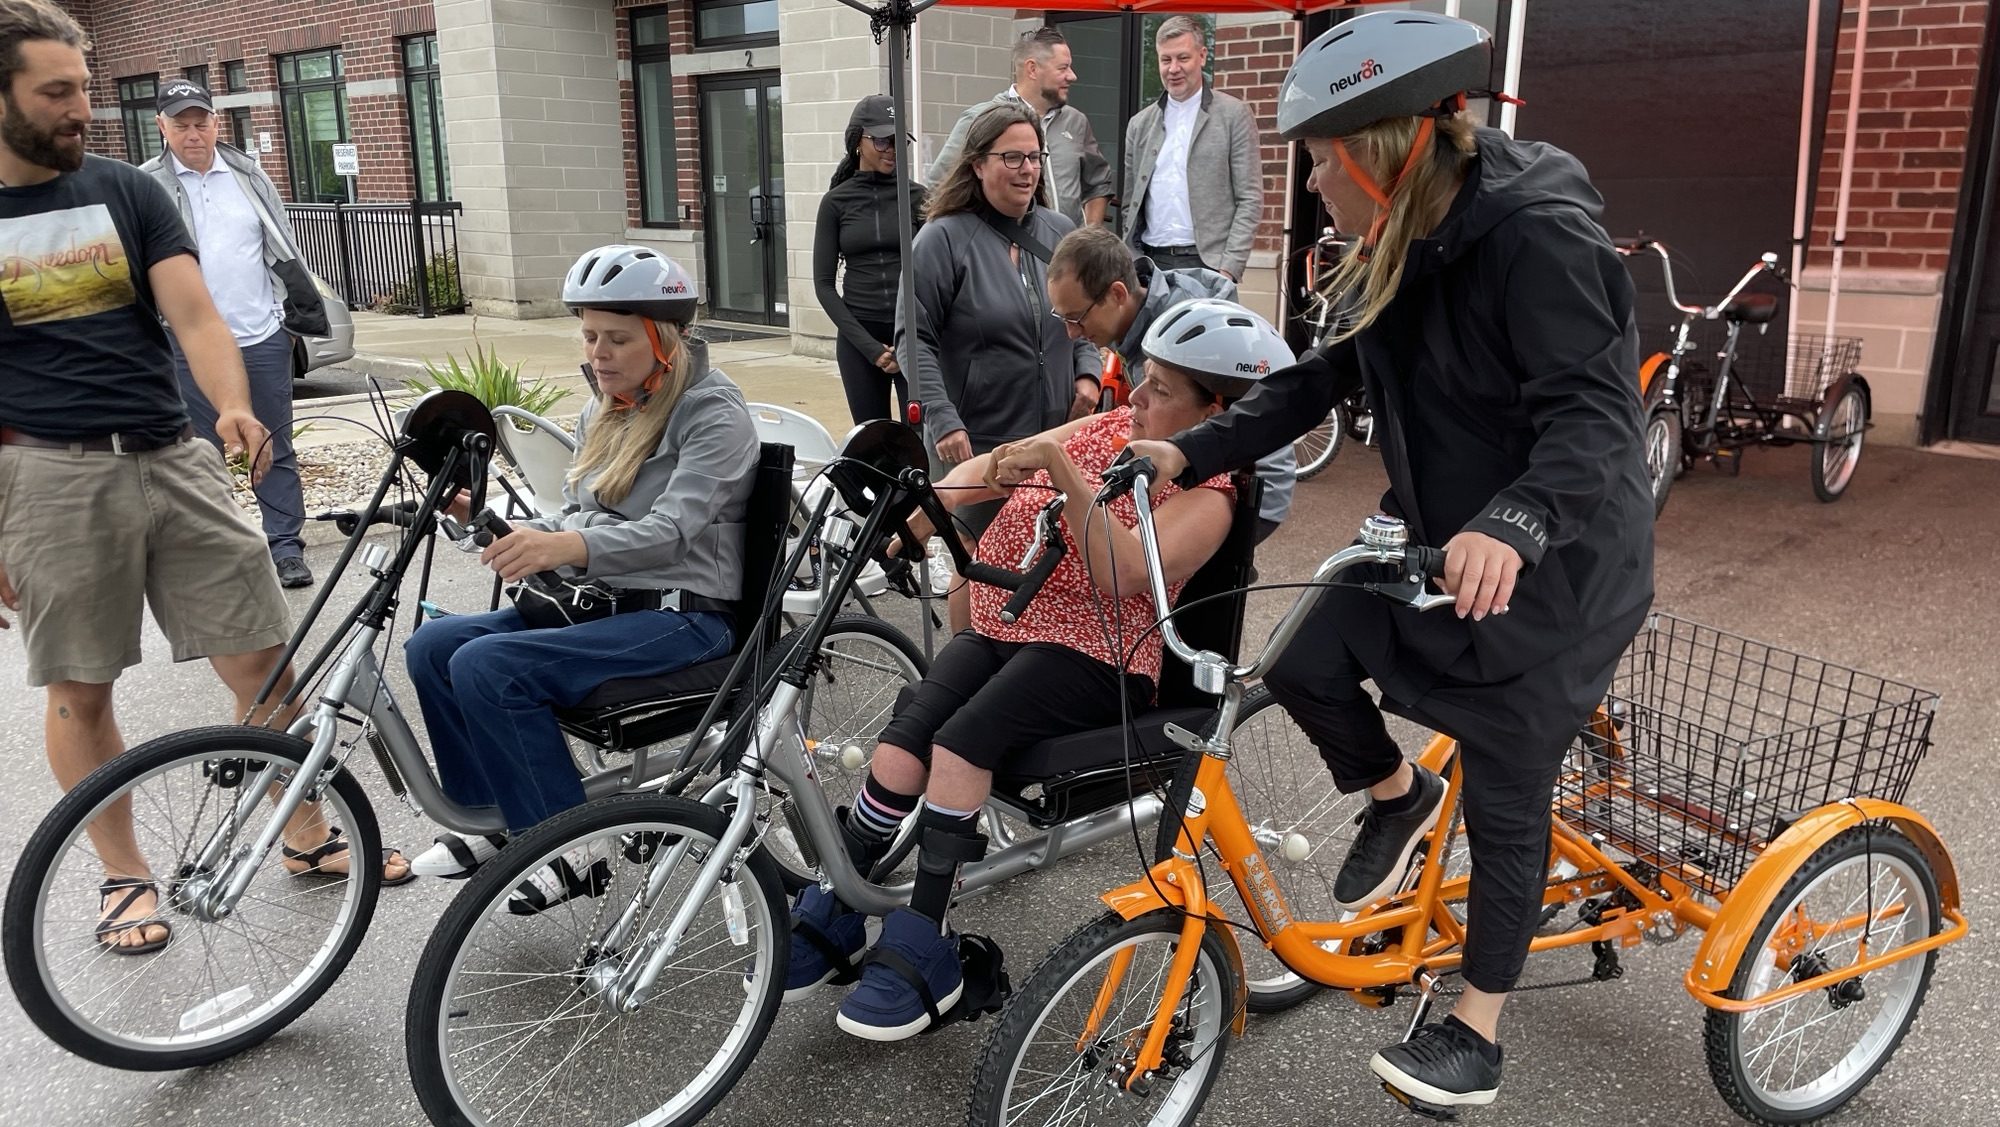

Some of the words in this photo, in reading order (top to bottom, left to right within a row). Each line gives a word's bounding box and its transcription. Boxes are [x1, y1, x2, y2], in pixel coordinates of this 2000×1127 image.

[745, 50, 753, 67] 2
[1329, 59, 1384, 95] neuron
[661, 281, 688, 294] neuron
[1235, 359, 1271, 375] neuron
